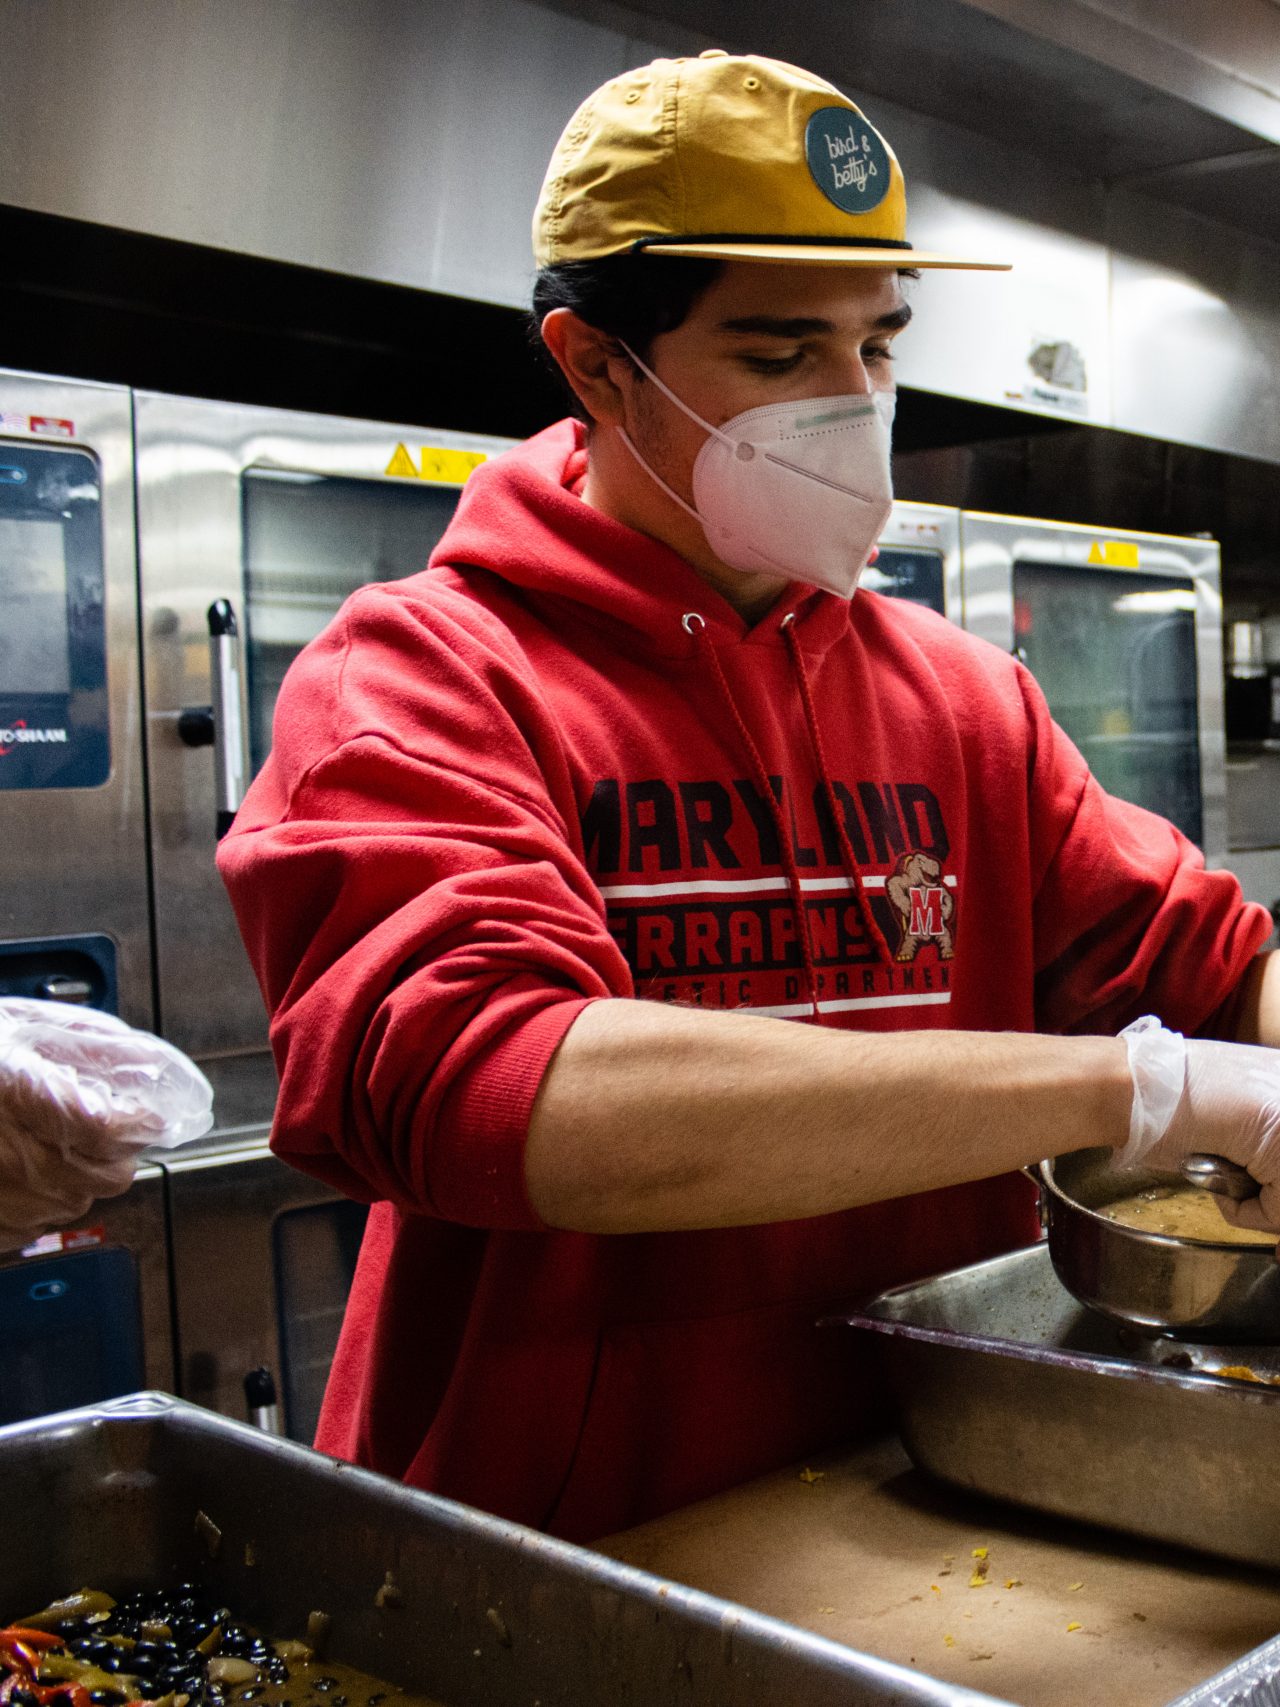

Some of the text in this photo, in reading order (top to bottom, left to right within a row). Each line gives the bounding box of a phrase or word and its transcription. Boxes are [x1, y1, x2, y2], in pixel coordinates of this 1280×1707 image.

[824, 125, 871, 159] bird &
[831, 154, 877, 192] betty's
[909, 887, 945, 936] M
[607, 906, 872, 970] RRAPNS
[785, 966, 949, 999] DPARTMEN
